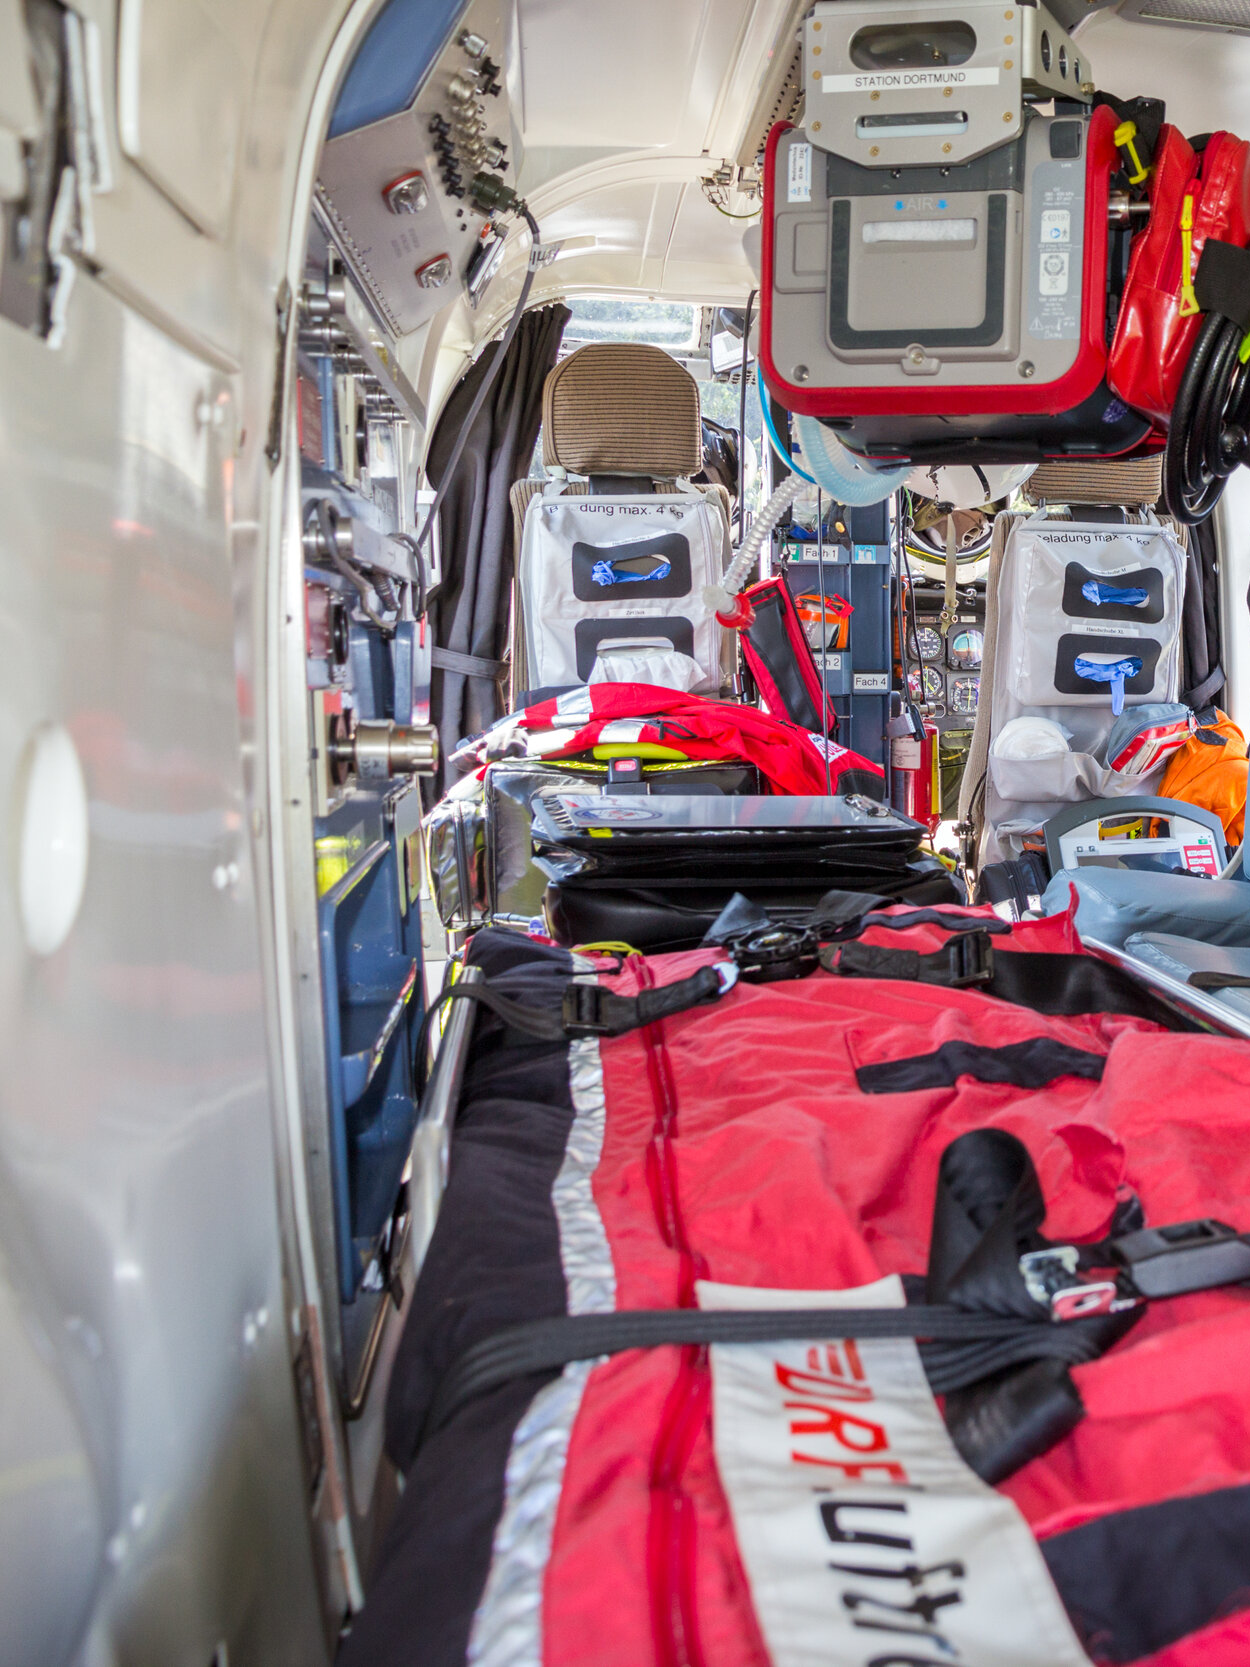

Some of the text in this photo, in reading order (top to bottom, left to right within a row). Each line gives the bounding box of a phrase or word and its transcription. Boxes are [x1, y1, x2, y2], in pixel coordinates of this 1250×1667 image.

[855, 72, 966, 88] STATION DORTMUND
[906, 197, 934, 211] AIR
[619, 506, 652, 515] max.
[656, 505, 664, 514] 4
[1037, 533, 1091, 544] eladung
[805, 549, 837, 558] Fah 1
[815, 657, 840, 667] ach 2
[855, 677, 886, 686] Fach 4
[813, 1485, 966, 1666] uftr
